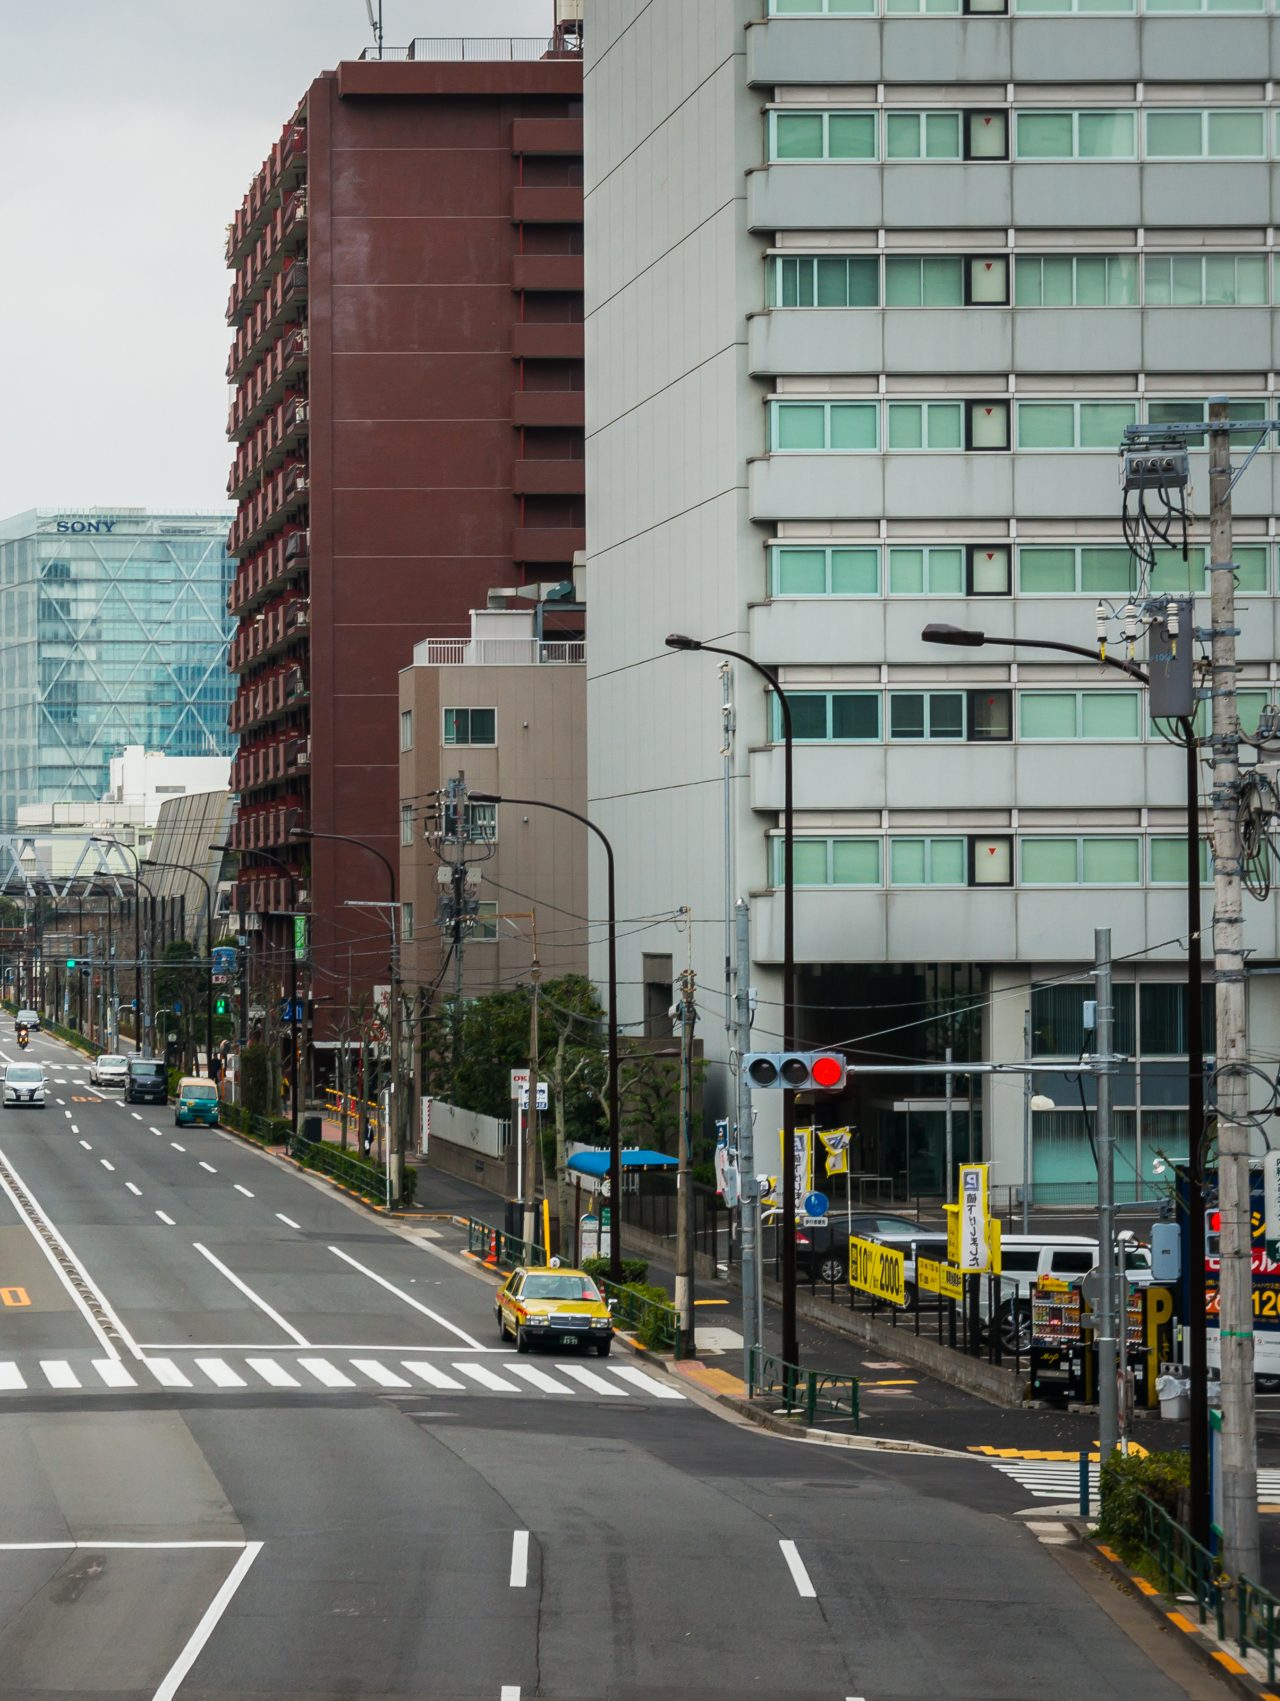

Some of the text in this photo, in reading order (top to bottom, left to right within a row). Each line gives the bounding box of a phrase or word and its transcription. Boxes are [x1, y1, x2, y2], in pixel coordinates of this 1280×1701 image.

[56, 520, 117, 533] SONY
[879, 1252, 900, 1296] 2000
[1251, 1290, 1280, 1317] 12
